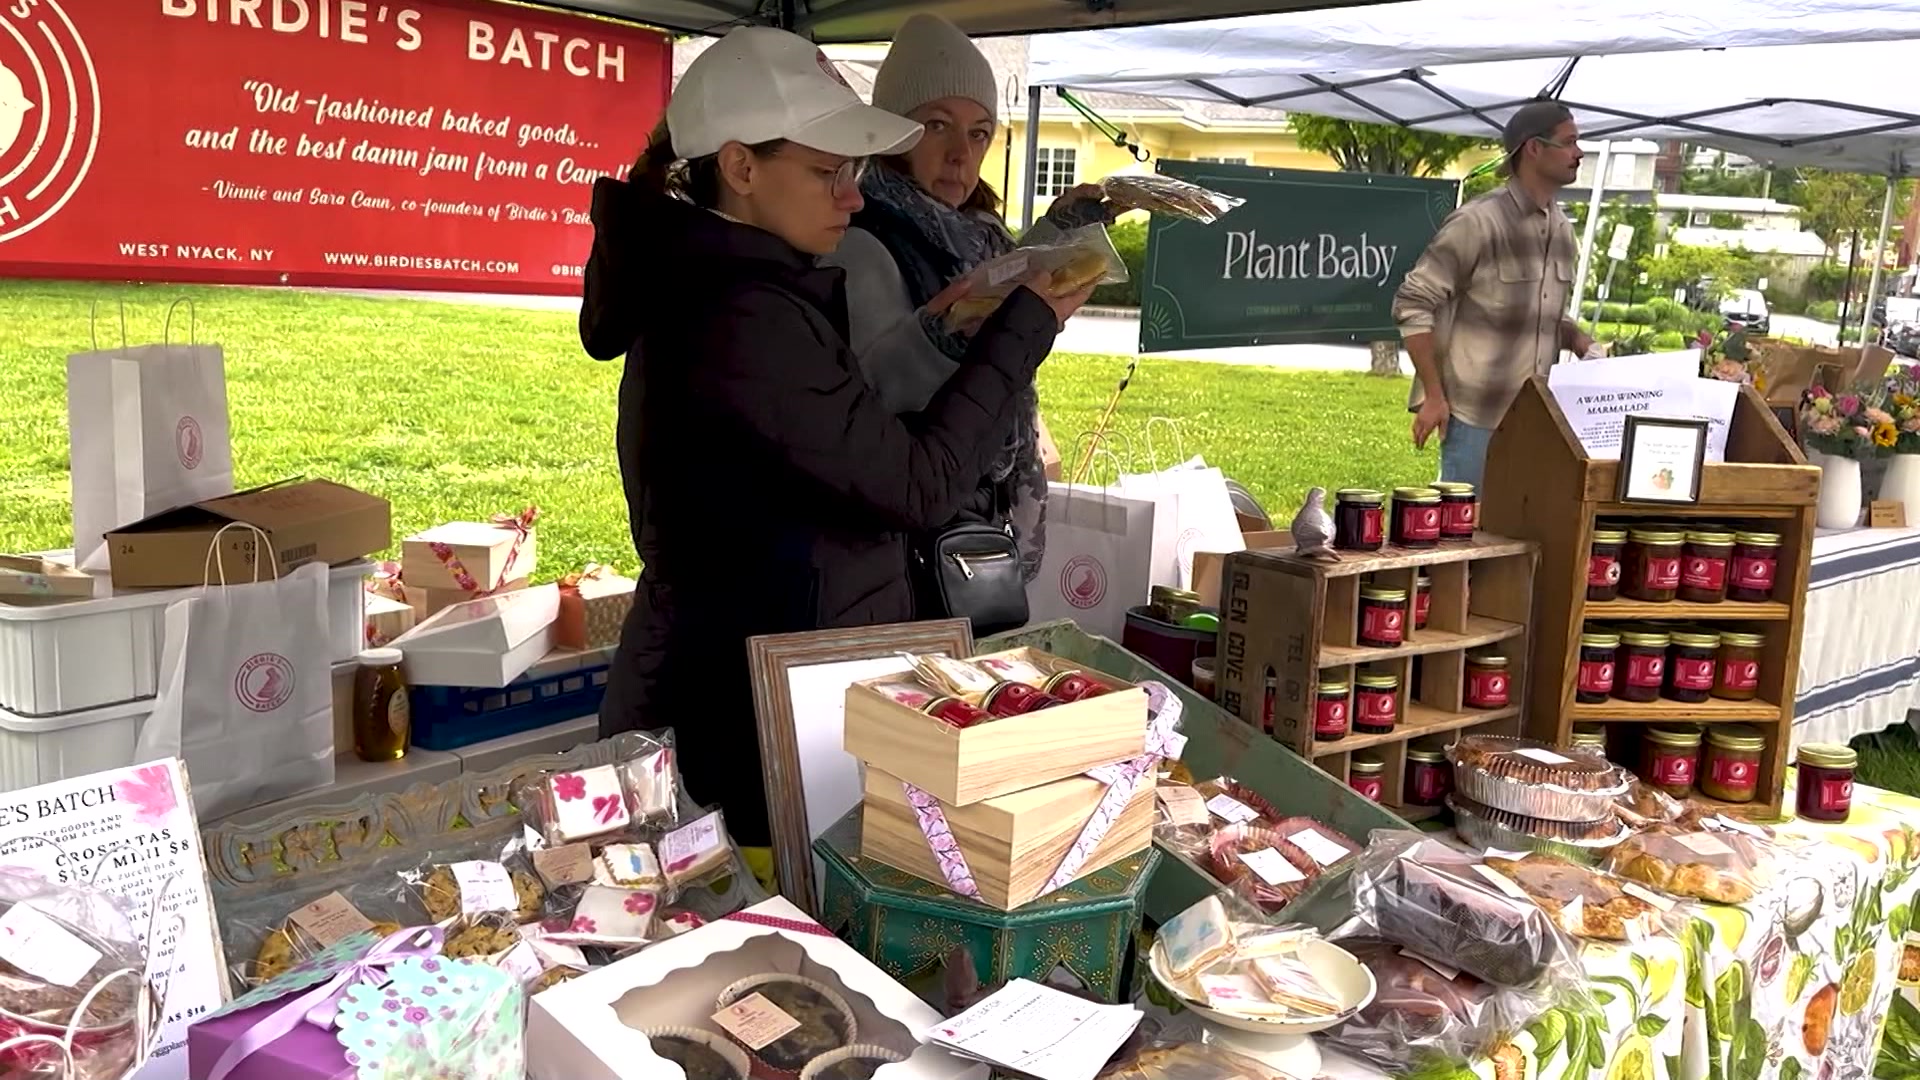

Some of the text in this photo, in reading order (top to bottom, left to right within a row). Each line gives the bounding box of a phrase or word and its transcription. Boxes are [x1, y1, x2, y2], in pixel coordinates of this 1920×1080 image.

[468, 20, 625, 82] BATCH
[441, 108, 511, 138] baked
[517, 123, 599, 148] goods...
[185, 126, 240, 151] and
[248, 128, 288, 156] the
[295, 133, 347, 160] best
[351, 140, 418, 168] damn
[418, 146, 469, 176] jam
[474, 151, 528, 182] from
[535, 164, 549, 180] a
[213, 179, 268, 201] Vinnie
[272, 188, 304, 204] and
[308, 187, 346, 206] Sara
[350, 190, 396, 212] Cann,
[487, 204, 501, 222] of
[505, 202, 557, 223] Birdie's
[119, 243, 274, 261] WEST NYACK, NY
[324, 252, 519, 274] WWW.BIRDIESBATCH.COM
[1221, 229, 1398, 288] Plant Baby
[550, 264, 585, 277] @BIR
[1576, 390, 1664, 405] AWARD WINNING
[1586, 402, 1650, 415] MARMALADE
[1231, 572, 1250, 624] GLEN
[1226, 631, 1246, 682] COVE
[1287, 633, 1305, 663] TEL
[36, 784, 117, 819] BATCH
[22, 840, 44, 851] JAM
[92, 823, 122, 835] CANN
[60, 820, 96, 834] GOODS
[100, 814, 122, 824] AND
[169, 838, 190, 855] $8
